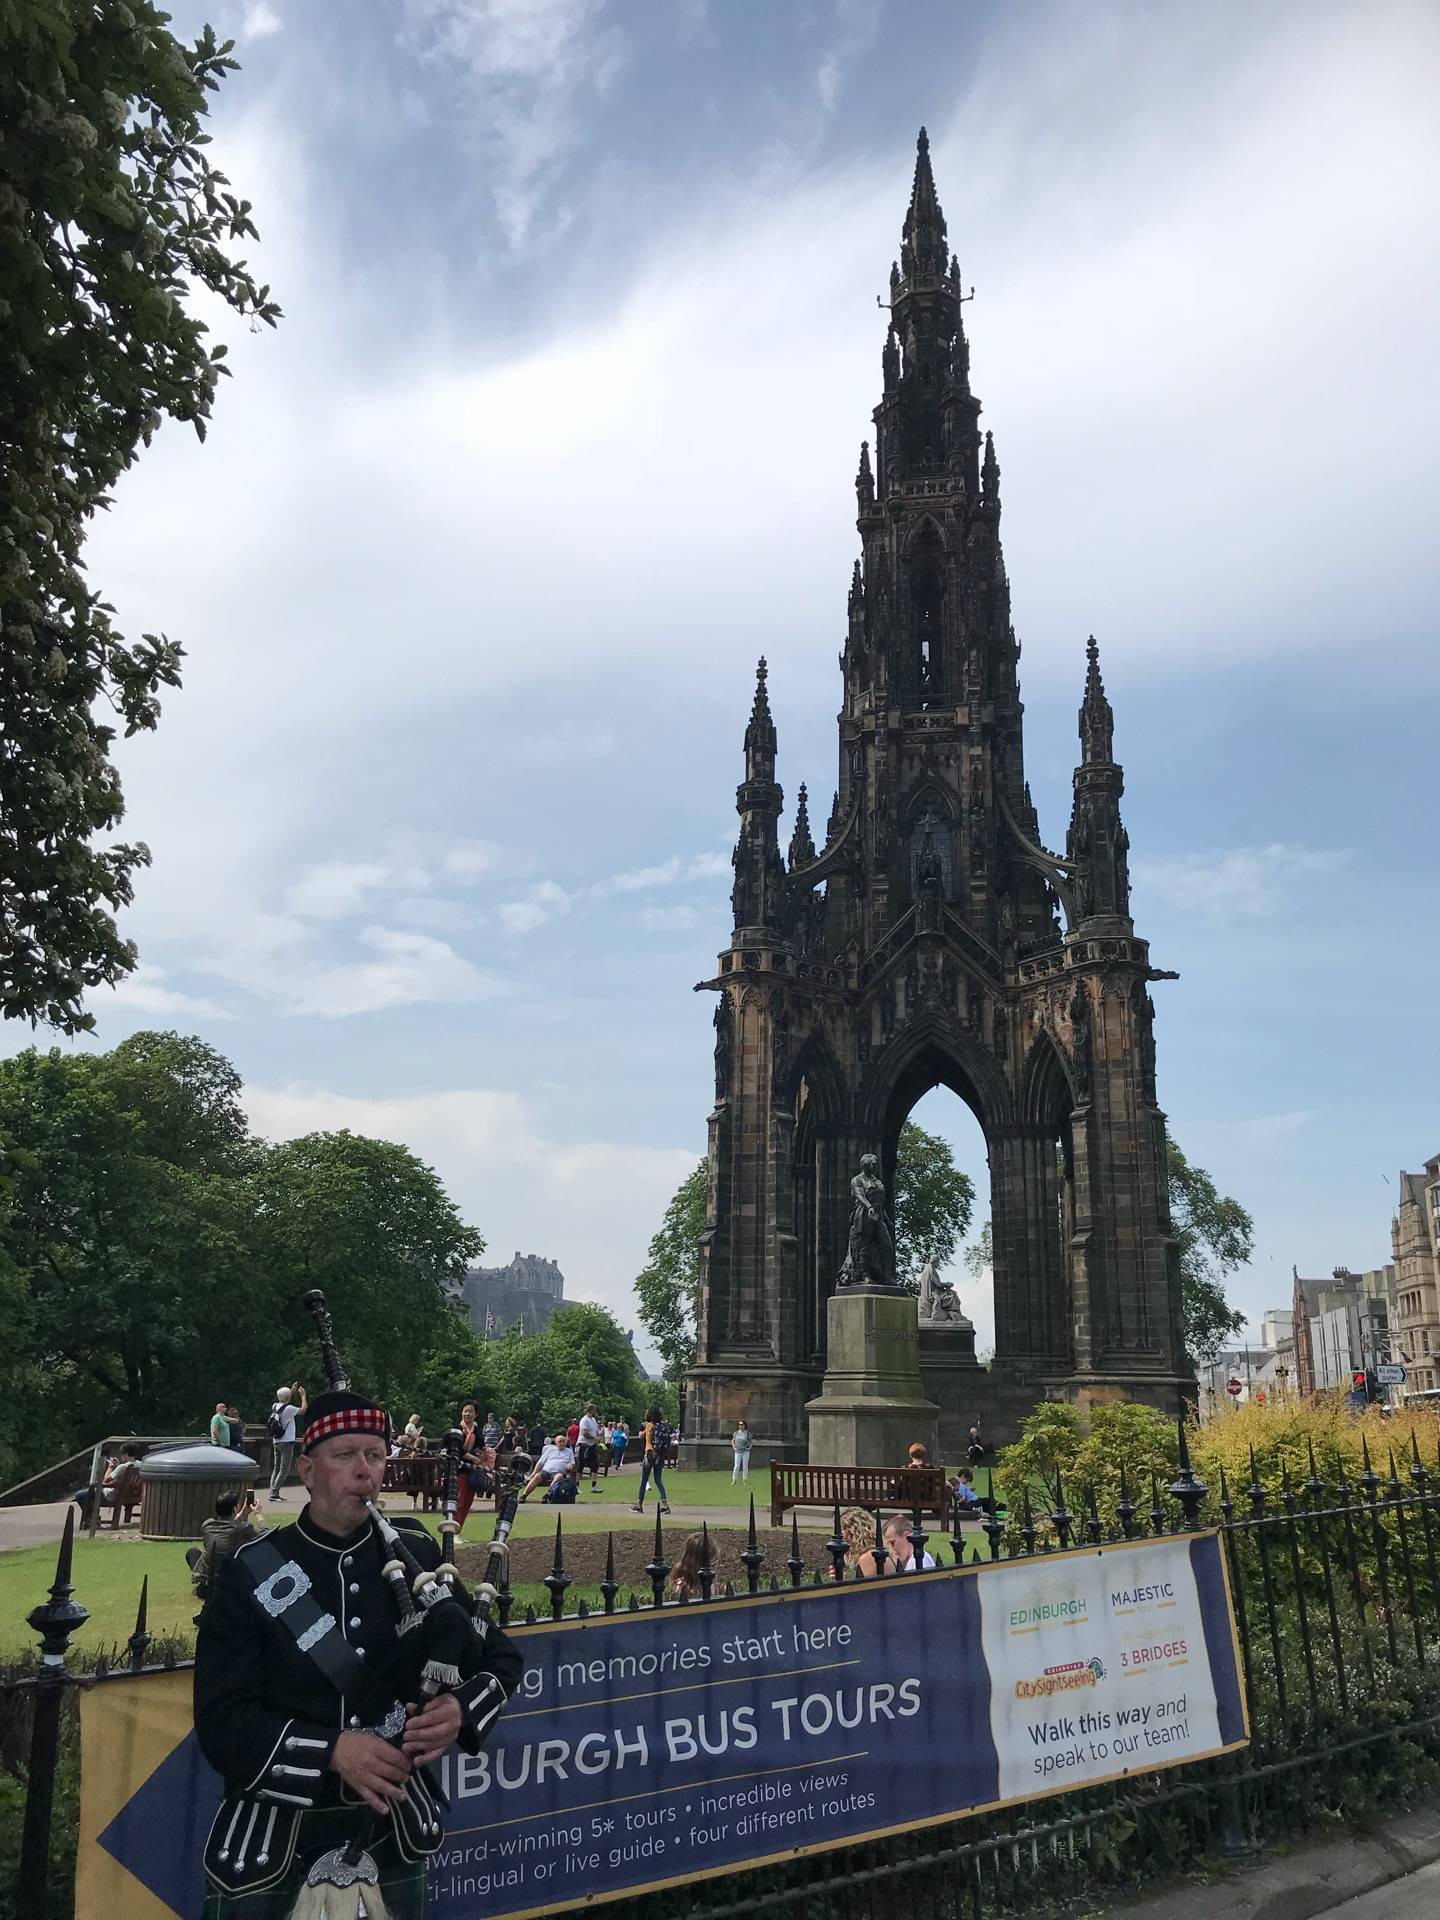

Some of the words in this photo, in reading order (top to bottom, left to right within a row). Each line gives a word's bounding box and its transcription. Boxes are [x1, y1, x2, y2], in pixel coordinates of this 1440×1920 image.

[1010, 1599, 1087, 1625] EDINBURGH
[1112, 1583, 1173, 1606] MAJESTIC
[516, 1667, 543, 1698] g
[557, 1643, 712, 1688] memories
[722, 1629, 785, 1663] start
[793, 1621, 852, 1652] here
[1120, 1652, 1128, 1667] 3
[1132, 1640, 1188, 1664] BRIDGES
[1016, 1671, 1096, 1697] CitySightseeing
[665, 1707, 759, 1762] BUS
[772, 1678, 921, 1741] TOURS
[1028, 1715, 1075, 1745] Walk
[1079, 1711, 1110, 1734] this
[1116, 1706, 1151, 1727] way
[1156, 1694, 1187, 1718] and
[1034, 1744, 1085, 1775] speak
[1089, 1741, 1108, 1760] to
[1113, 1731, 1140, 1754] our
[1144, 1719, 1190, 1747] team!
[625, 1803, 676, 1831] tours
[700, 1779, 792, 1814] incredible
[799, 1770, 849, 1793] views
[533, 1859, 557, 1878] or
[565, 1844, 601, 1873] live
[608, 1835, 666, 1869] guide
[689, 1822, 728, 1846] four
[736, 1803, 815, 1836] different
[821, 1791, 876, 1818] routes
